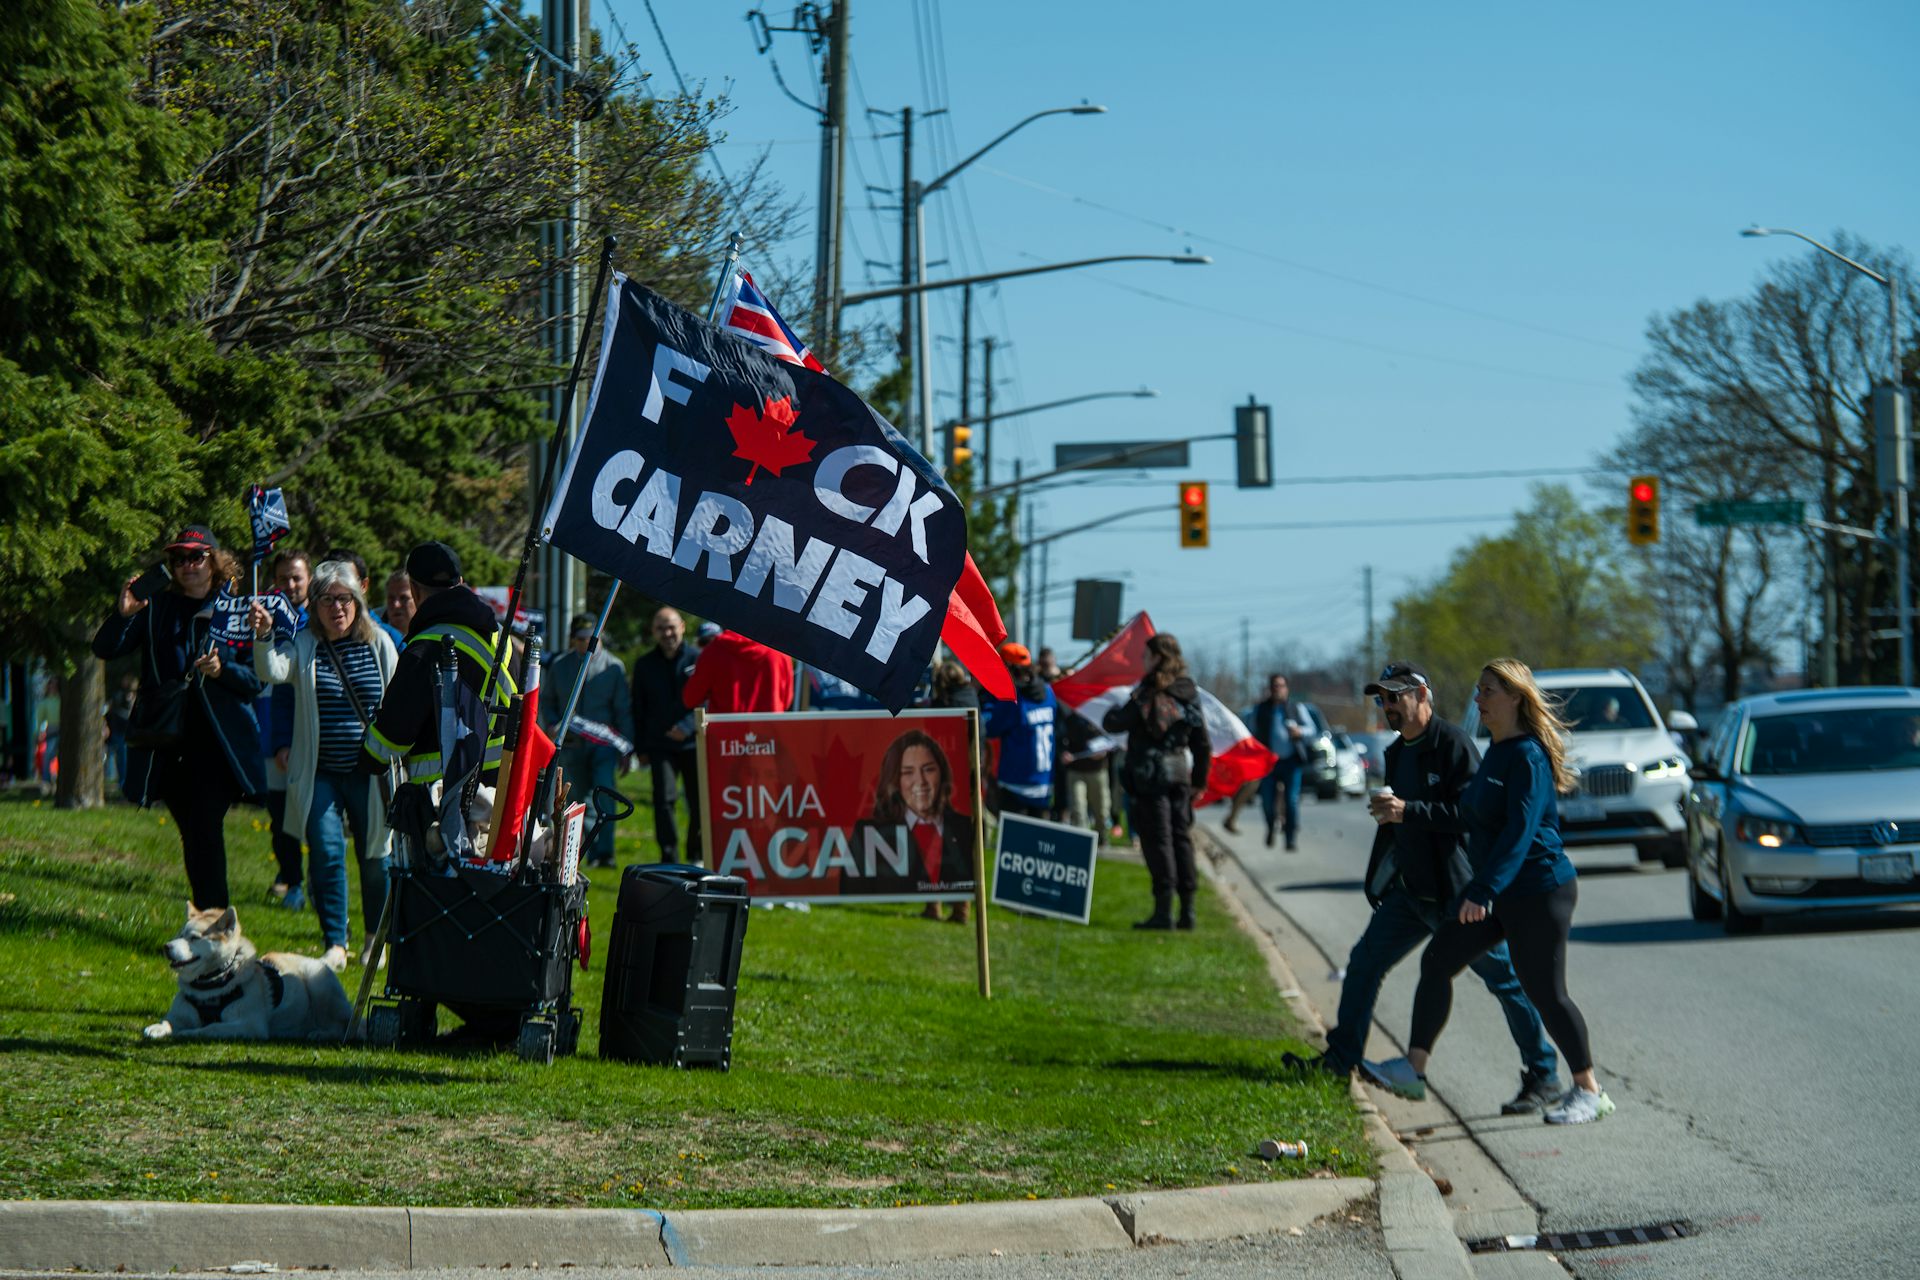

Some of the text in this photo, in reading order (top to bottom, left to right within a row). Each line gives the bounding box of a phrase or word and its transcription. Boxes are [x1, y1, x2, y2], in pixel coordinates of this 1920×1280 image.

[591, 449, 933, 665] CARNEY
[720, 738, 776, 756] Liberal
[721, 783, 826, 820] SIMA
[718, 824, 910, 880] ACAN
[1037, 840, 1056, 856] TIM
[1000, 850, 1089, 888] CROWDER
